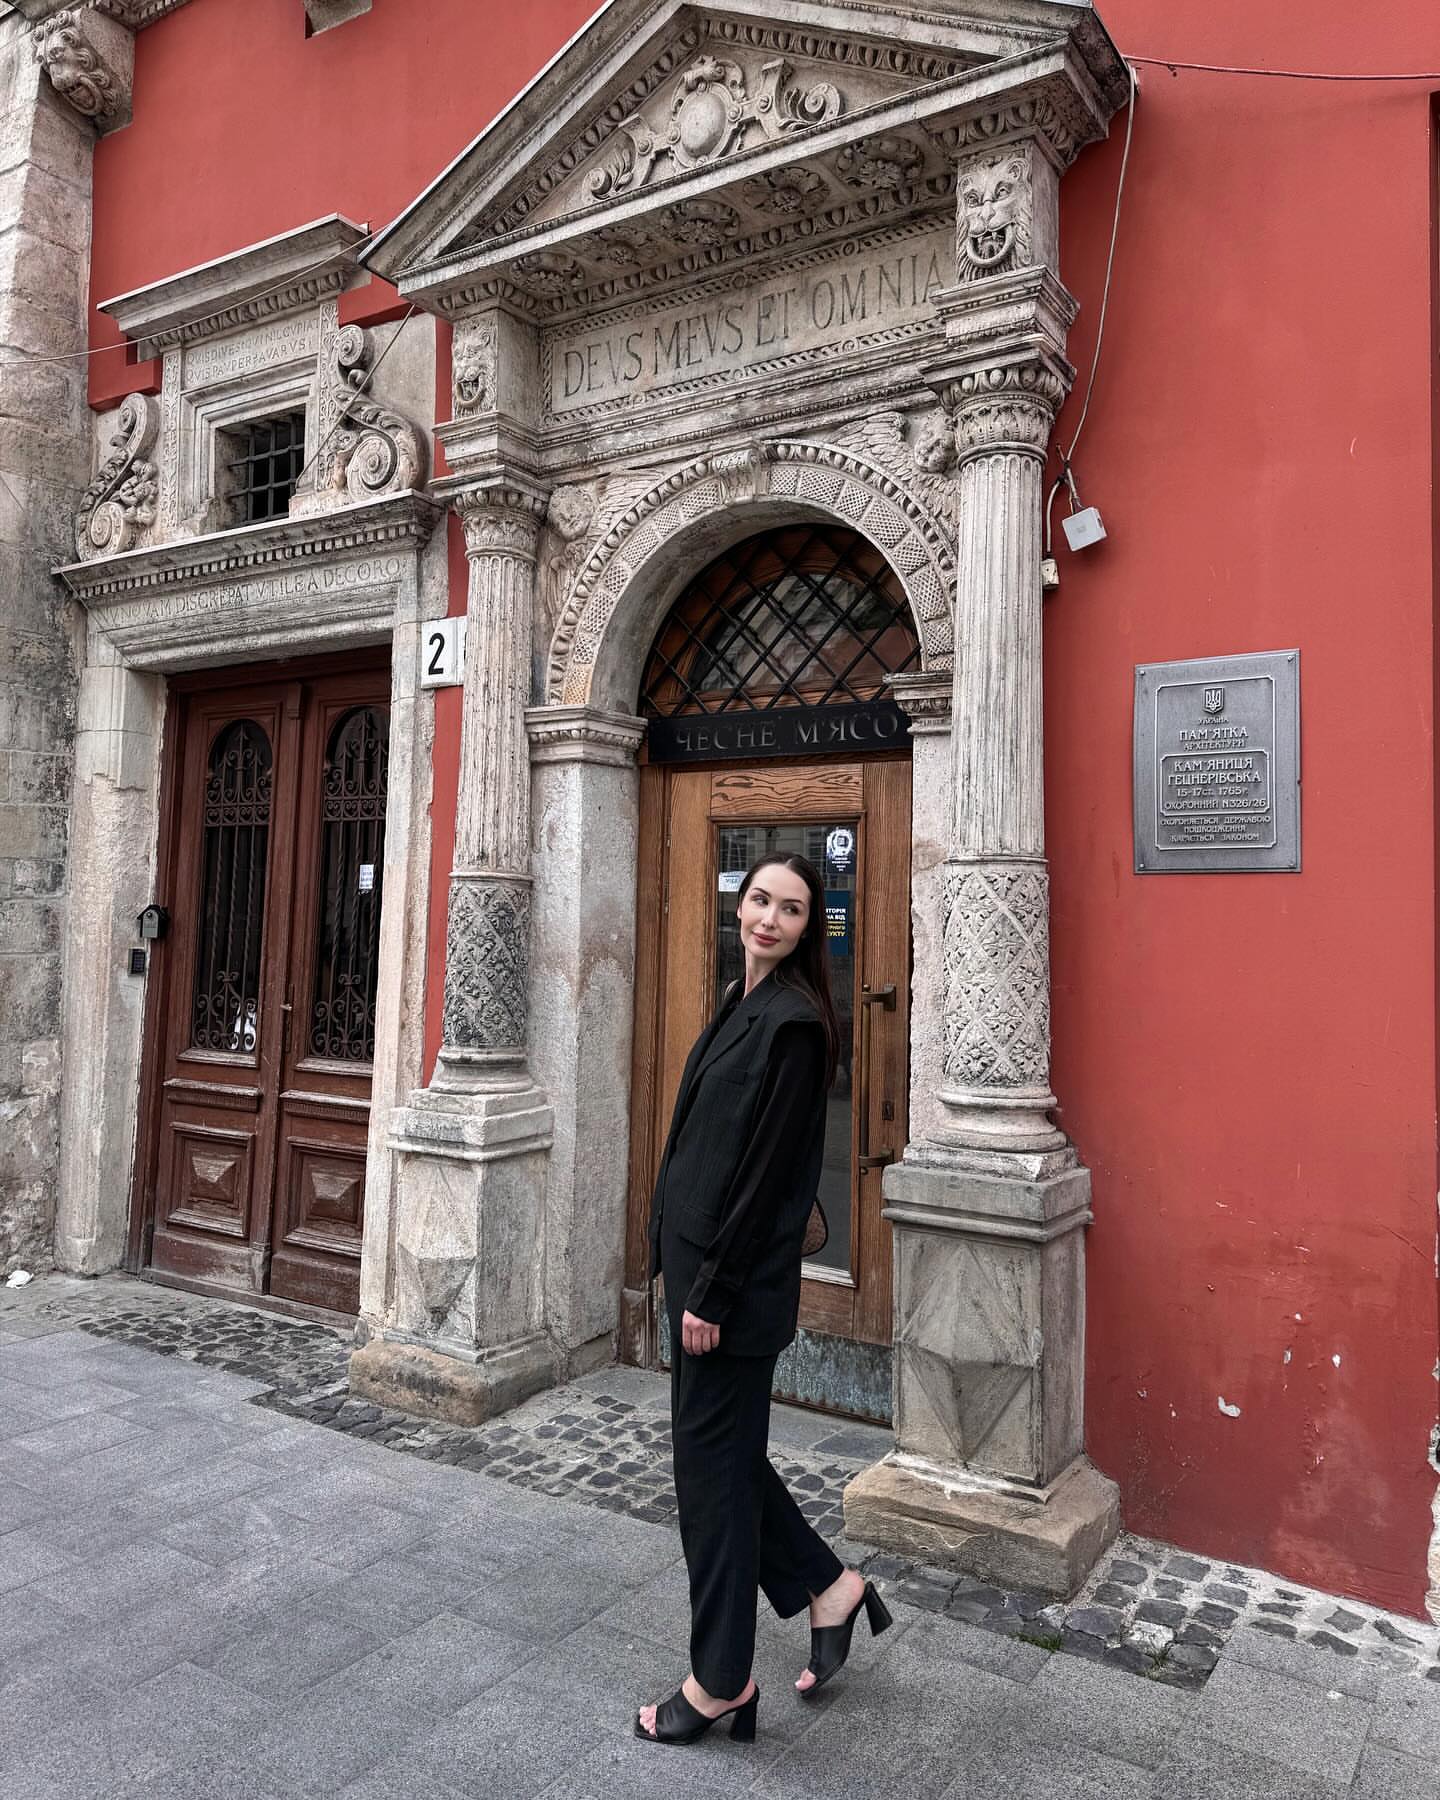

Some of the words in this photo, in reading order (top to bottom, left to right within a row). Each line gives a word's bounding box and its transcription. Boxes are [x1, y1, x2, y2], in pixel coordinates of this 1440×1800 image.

[564, 332, 643, 398] DEVS
[653, 304, 744, 376] MEVS
[755, 288, 797, 347] ET
[811, 249, 945, 330] OMNIA
[428, 632, 445, 675] 2
[676, 720, 777, 751] ЧЕСНЕ
